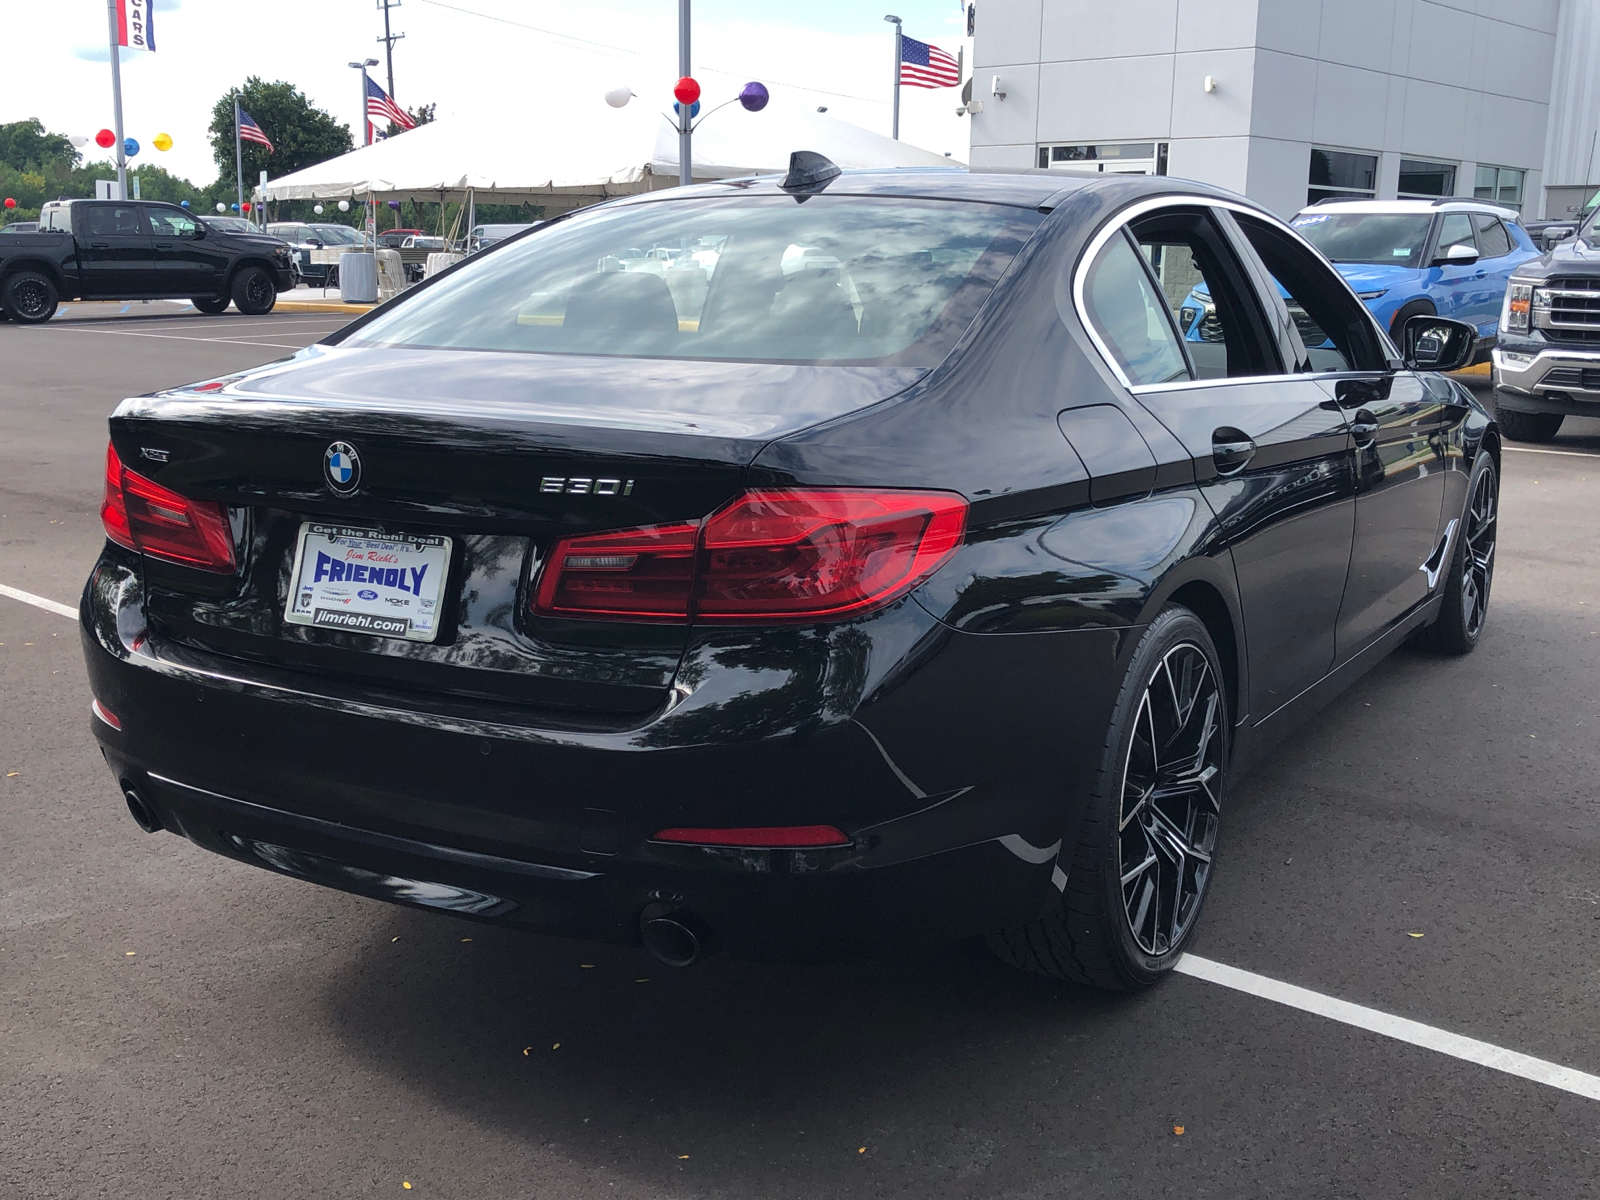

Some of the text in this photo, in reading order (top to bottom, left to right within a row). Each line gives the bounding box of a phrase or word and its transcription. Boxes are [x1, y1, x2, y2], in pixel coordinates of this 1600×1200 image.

[326, 443, 357, 461] BMW
[539, 477, 635, 496] 530i
[313, 525, 440, 545] Get the Riehl Deal
[347, 540, 363, 549] Your
[344, 549, 399, 564] Jim Riehl's
[313, 550, 430, 597] FRIENDLY
[384, 597, 410, 605] MOKE
[315, 610, 405, 632] jimriehl.com
